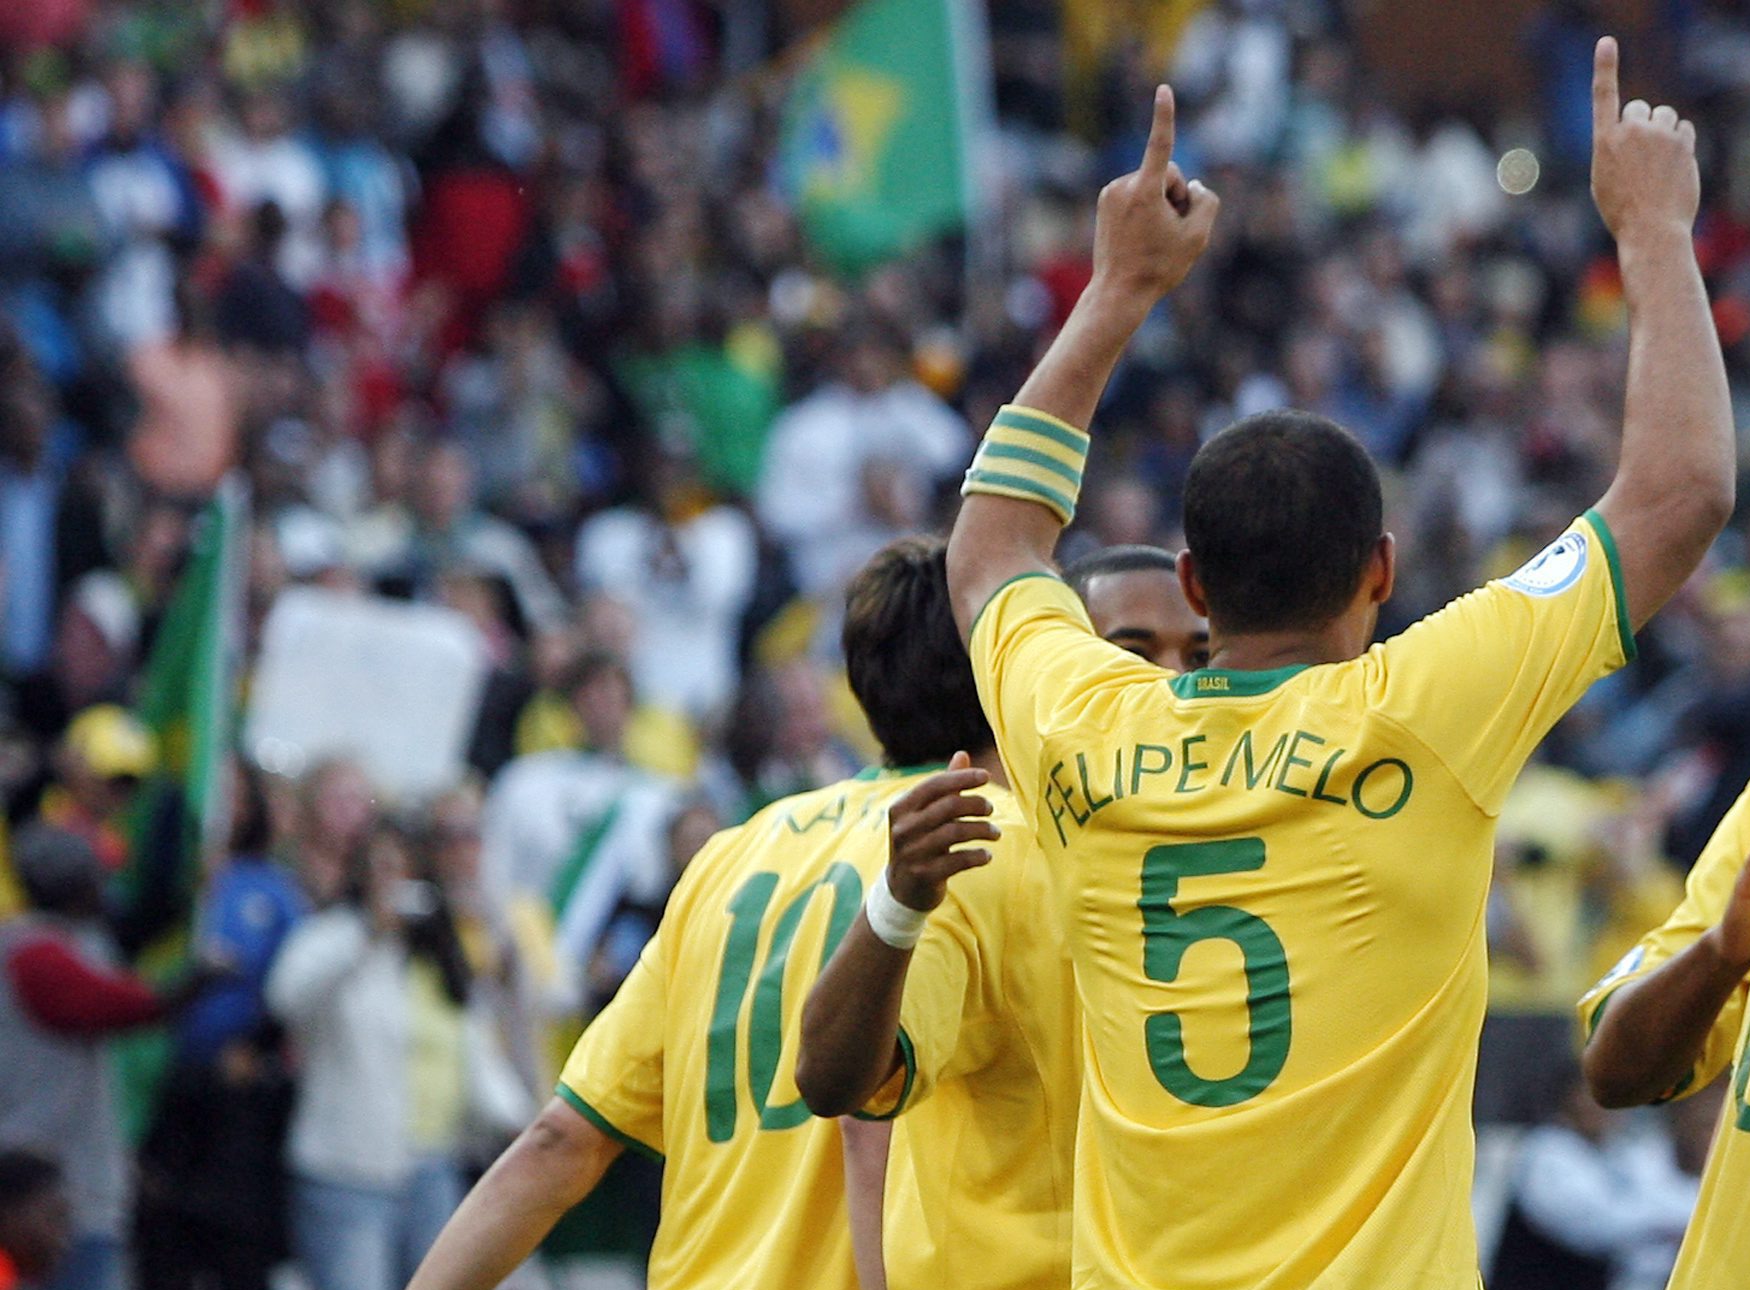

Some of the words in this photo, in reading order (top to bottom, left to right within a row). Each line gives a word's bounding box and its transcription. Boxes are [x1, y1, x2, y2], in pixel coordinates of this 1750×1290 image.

[1196, 676, 1231, 692] BRASIL
[1043, 733, 1209, 849] FELIPE
[1220, 728, 1414, 820] MELO
[705, 861, 864, 1144] 10
[1136, 836, 1293, 1108] 5
